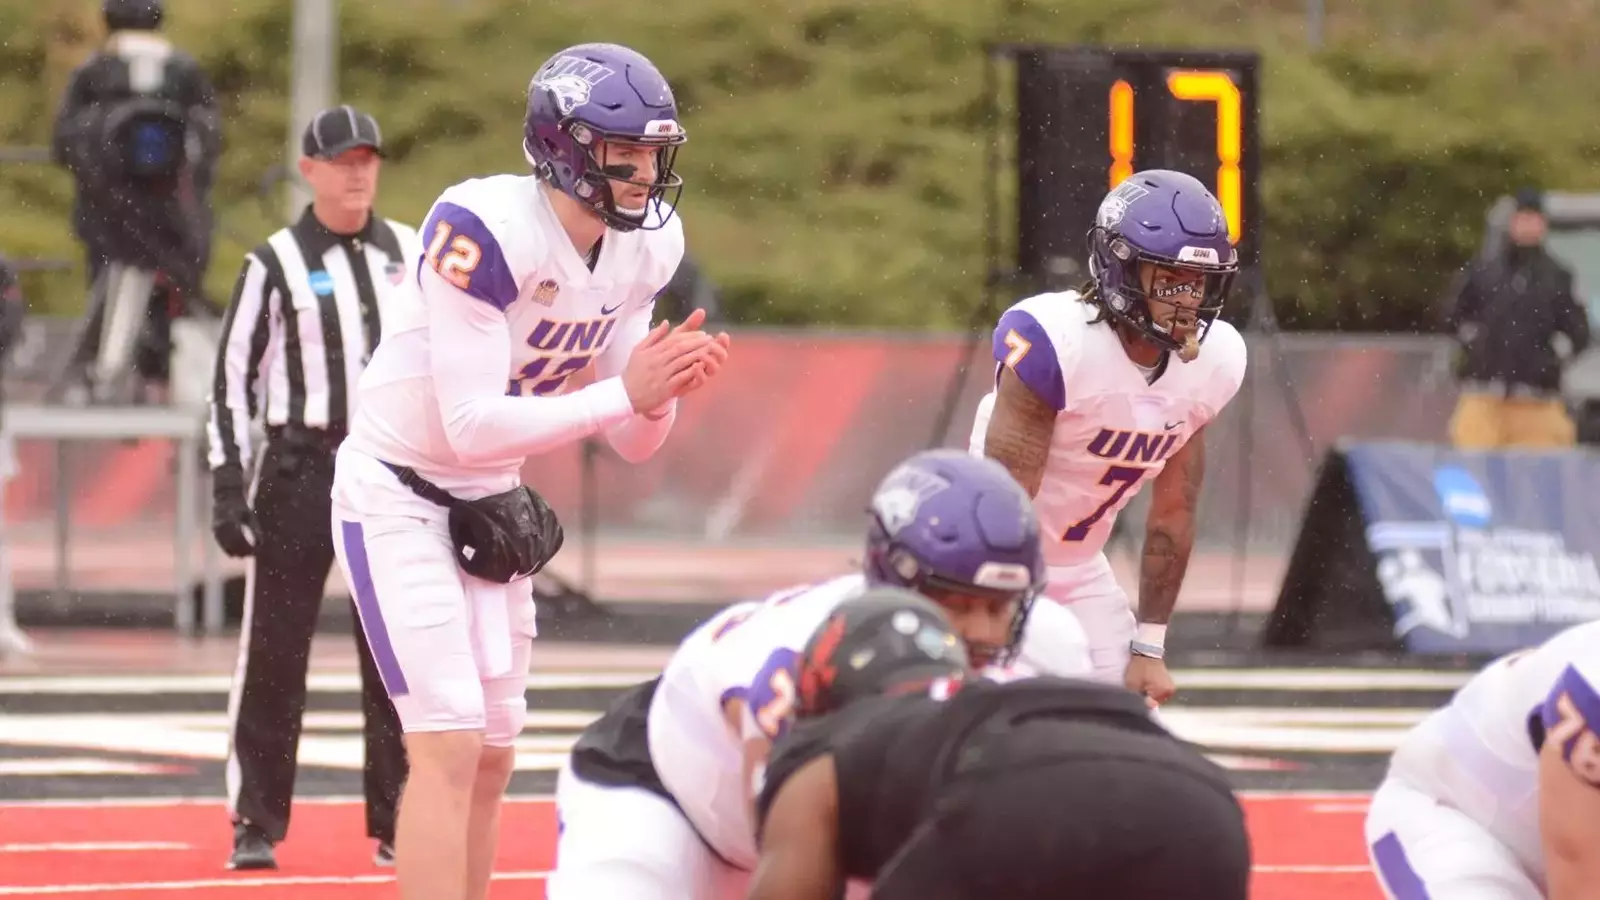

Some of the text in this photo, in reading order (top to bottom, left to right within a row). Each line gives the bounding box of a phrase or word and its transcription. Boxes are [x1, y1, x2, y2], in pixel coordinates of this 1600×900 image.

[657, 123, 673, 133] UNI
[1108, 71, 1242, 245] 17
[425, 219, 482, 289] 12
[1192, 249, 1211, 259] UNI
[526, 316, 617, 351] UNI
[1003, 328, 1032, 370] 7
[1086, 427, 1180, 464] UNI
[1060, 464, 1149, 543] 7
